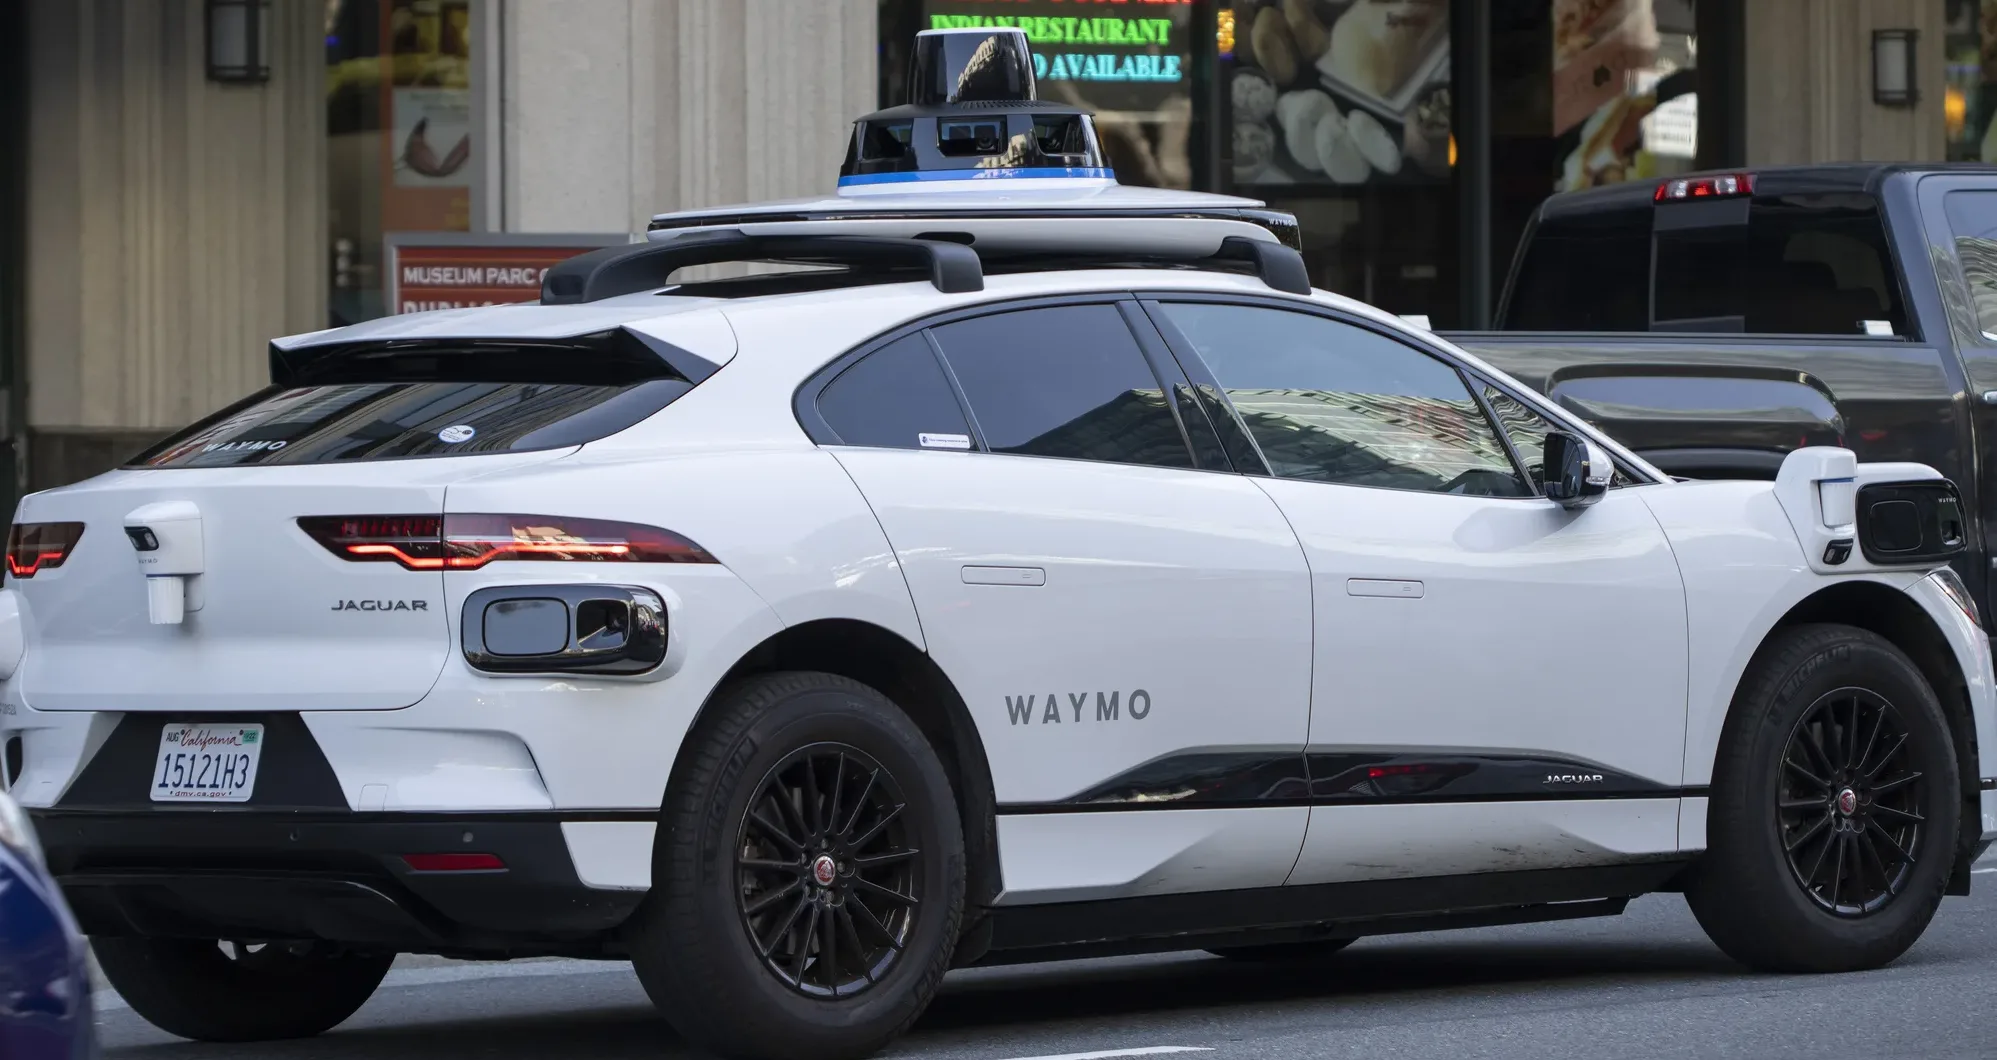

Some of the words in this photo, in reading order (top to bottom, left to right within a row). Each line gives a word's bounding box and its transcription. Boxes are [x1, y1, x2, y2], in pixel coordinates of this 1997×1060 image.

[1017, 16, 1172, 45] RESTAURANT
[1049, 54, 1182, 82] AVAILABLE
[403, 267, 483, 284] MUSEUM
[486, 267, 537, 285] PARC
[202, 440, 287, 452] WAYMO
[331, 599, 428, 611] JAGUAR
[1005, 689, 1151, 726] WAYMO
[166, 732, 179, 743] AUG
[181, 729, 242, 751] California
[158, 753, 250, 789] 15121H3
[1543, 775, 1603, 784] JAGUAR
